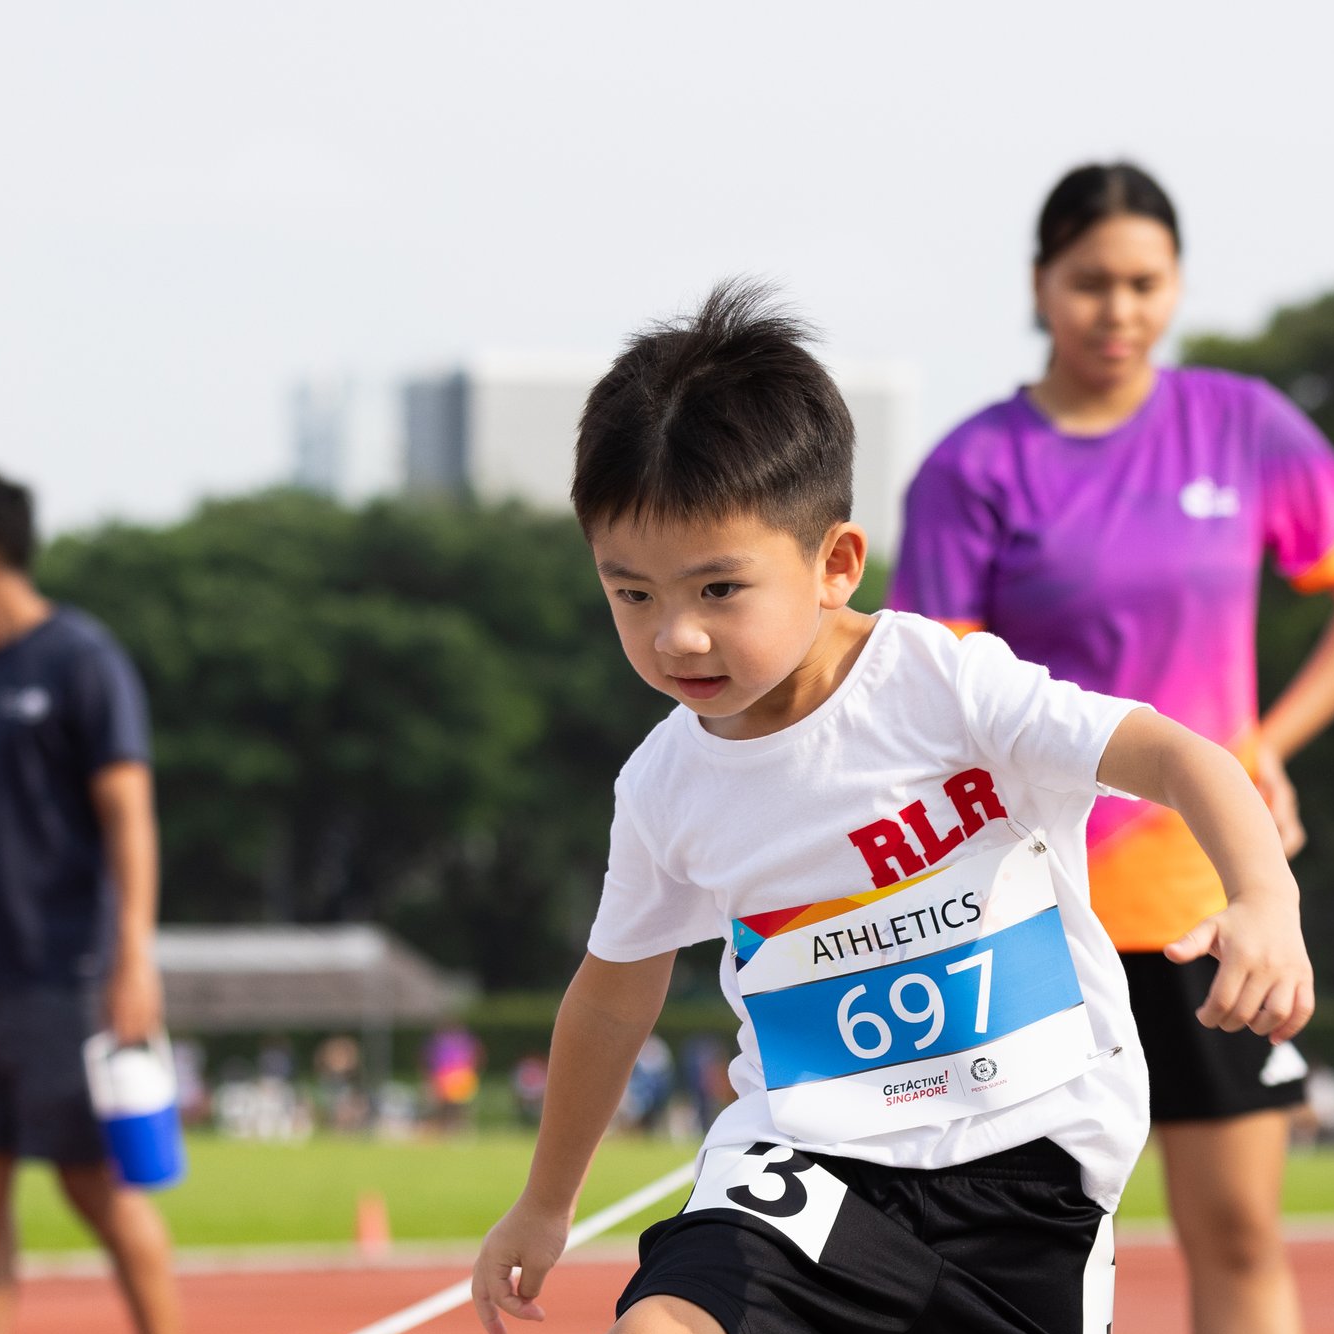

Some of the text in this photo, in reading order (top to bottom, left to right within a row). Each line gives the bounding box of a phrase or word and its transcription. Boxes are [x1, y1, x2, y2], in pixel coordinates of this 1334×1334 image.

[848, 767, 1008, 889] RLR
[812, 892, 981, 964] ATHLETICS
[836, 949, 993, 1060] 697
[885, 1085, 948, 1107] SINGAPORE
[726, 1141, 816, 1217] 3
